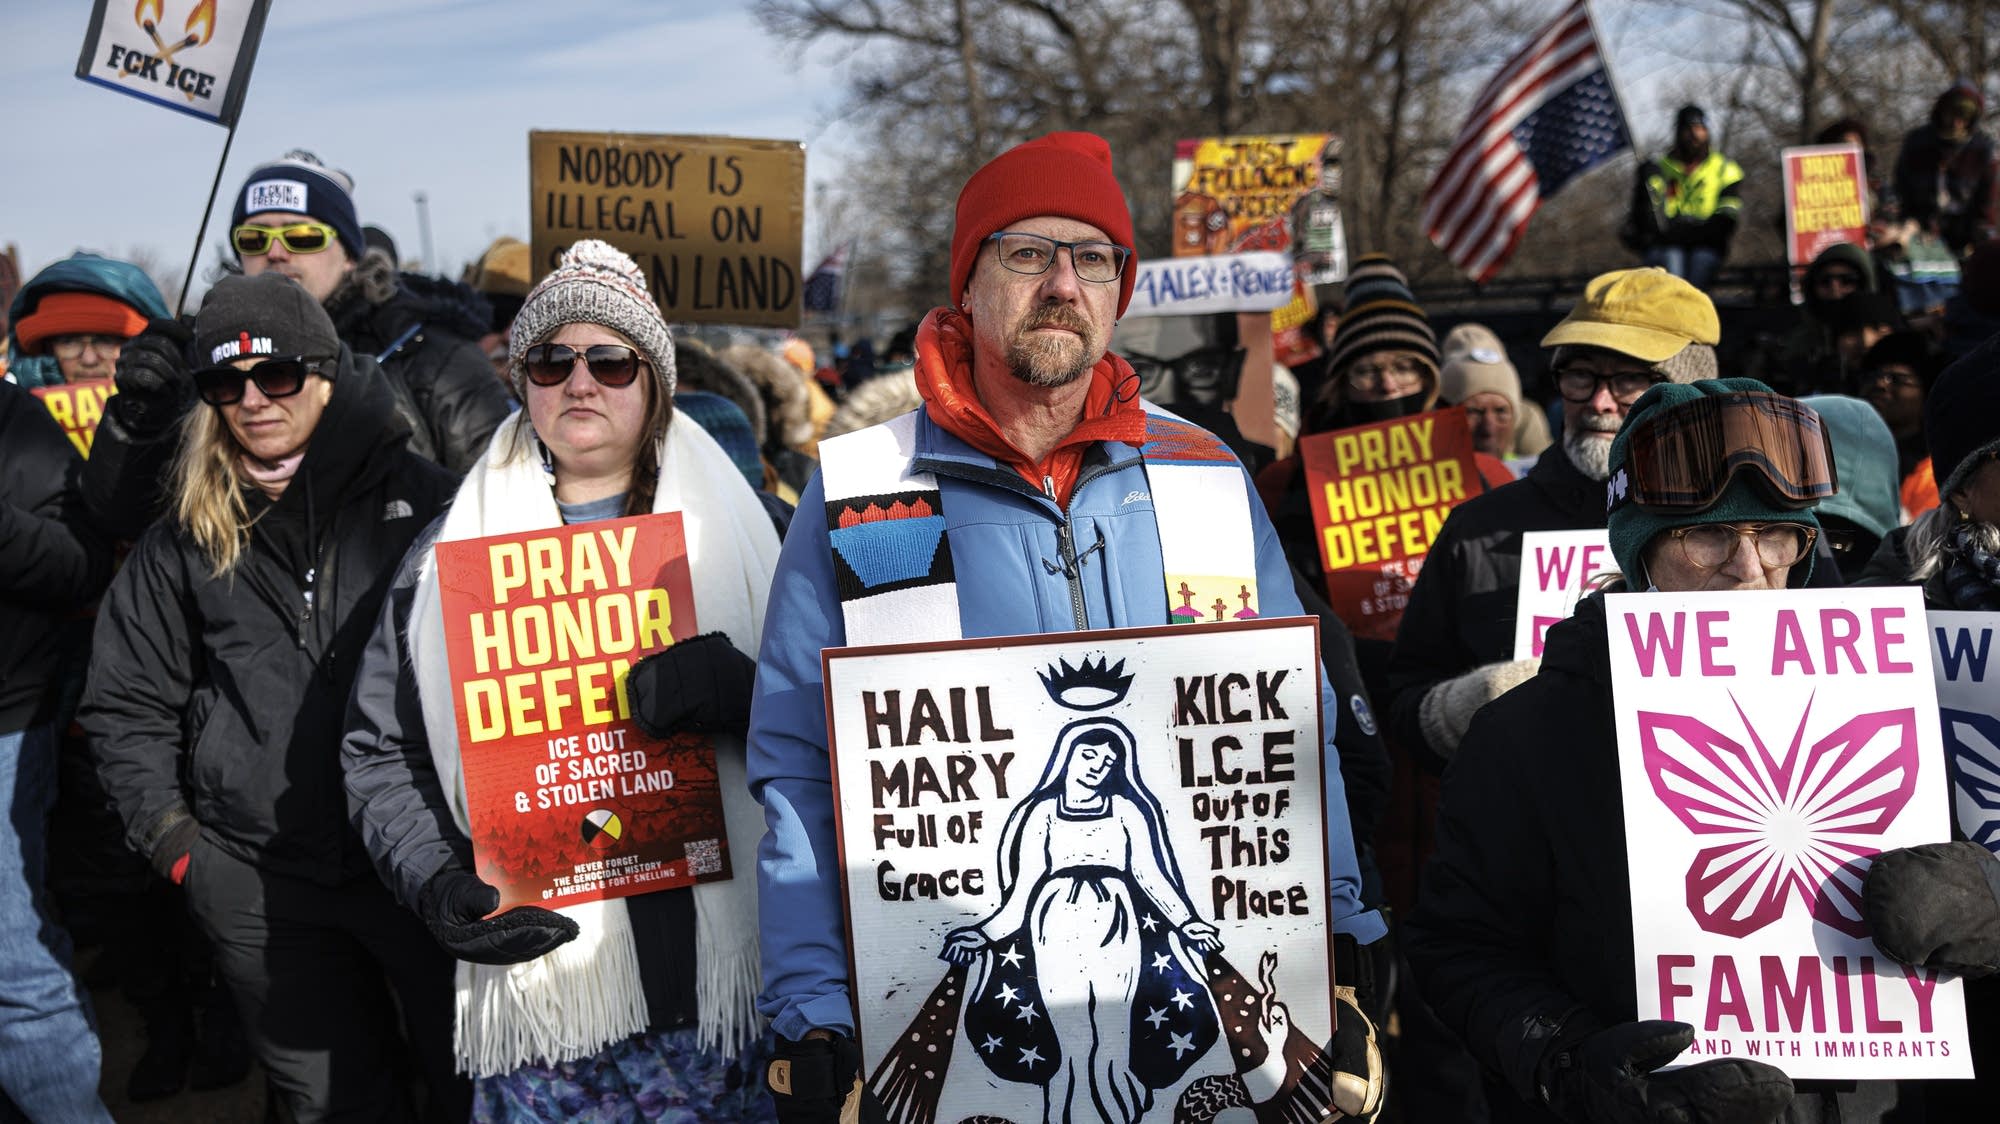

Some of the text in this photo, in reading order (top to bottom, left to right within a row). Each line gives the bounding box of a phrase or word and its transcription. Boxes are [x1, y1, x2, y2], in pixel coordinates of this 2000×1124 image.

[106, 44, 216, 99] FCK ICE
[558, 146, 743, 197] NOBODY IS
[547, 192, 762, 243] ILLEGAL ON
[692, 255, 796, 312] LAND
[1159, 266, 1219, 302] ALEX
[1229, 261, 1293, 298] RENEE
[211, 331, 272, 364] IRONMAN
[1334, 418, 1434, 477] PRAY
[1324, 459, 1465, 524] HONOR
[489, 526, 637, 605] PRAY
[1535, 545, 1605, 592] WE
[470, 588, 675, 674] HONOR
[1624, 607, 1914, 677] WE ARE
[862, 686, 1014, 749] HAIL
[1174, 669, 1290, 726] KICK
[535, 750, 647, 786] OF SACRED
[547, 729, 626, 760] ICE OUT
[514, 769, 674, 813] & STOLEN LAND
[870, 752, 1016, 809] MARY
[574, 855, 639, 874] NEVER FORGET
[1201, 825, 1290, 870] This
[542, 889, 554, 900] OF
[557, 882, 597, 897] AMERICA
[608, 876, 631, 888] FORT
[634, 868, 676, 883] SNELLING
[553, 861, 662, 888] THE GENOCIDAL HISTORY
[877, 860, 984, 901] Grace
[1211, 875, 1309, 921] Place
[1657, 955, 1941, 1034] FAMILY
[1680, 1039, 1950, 1058] AND WITH IMMIGRANTS
